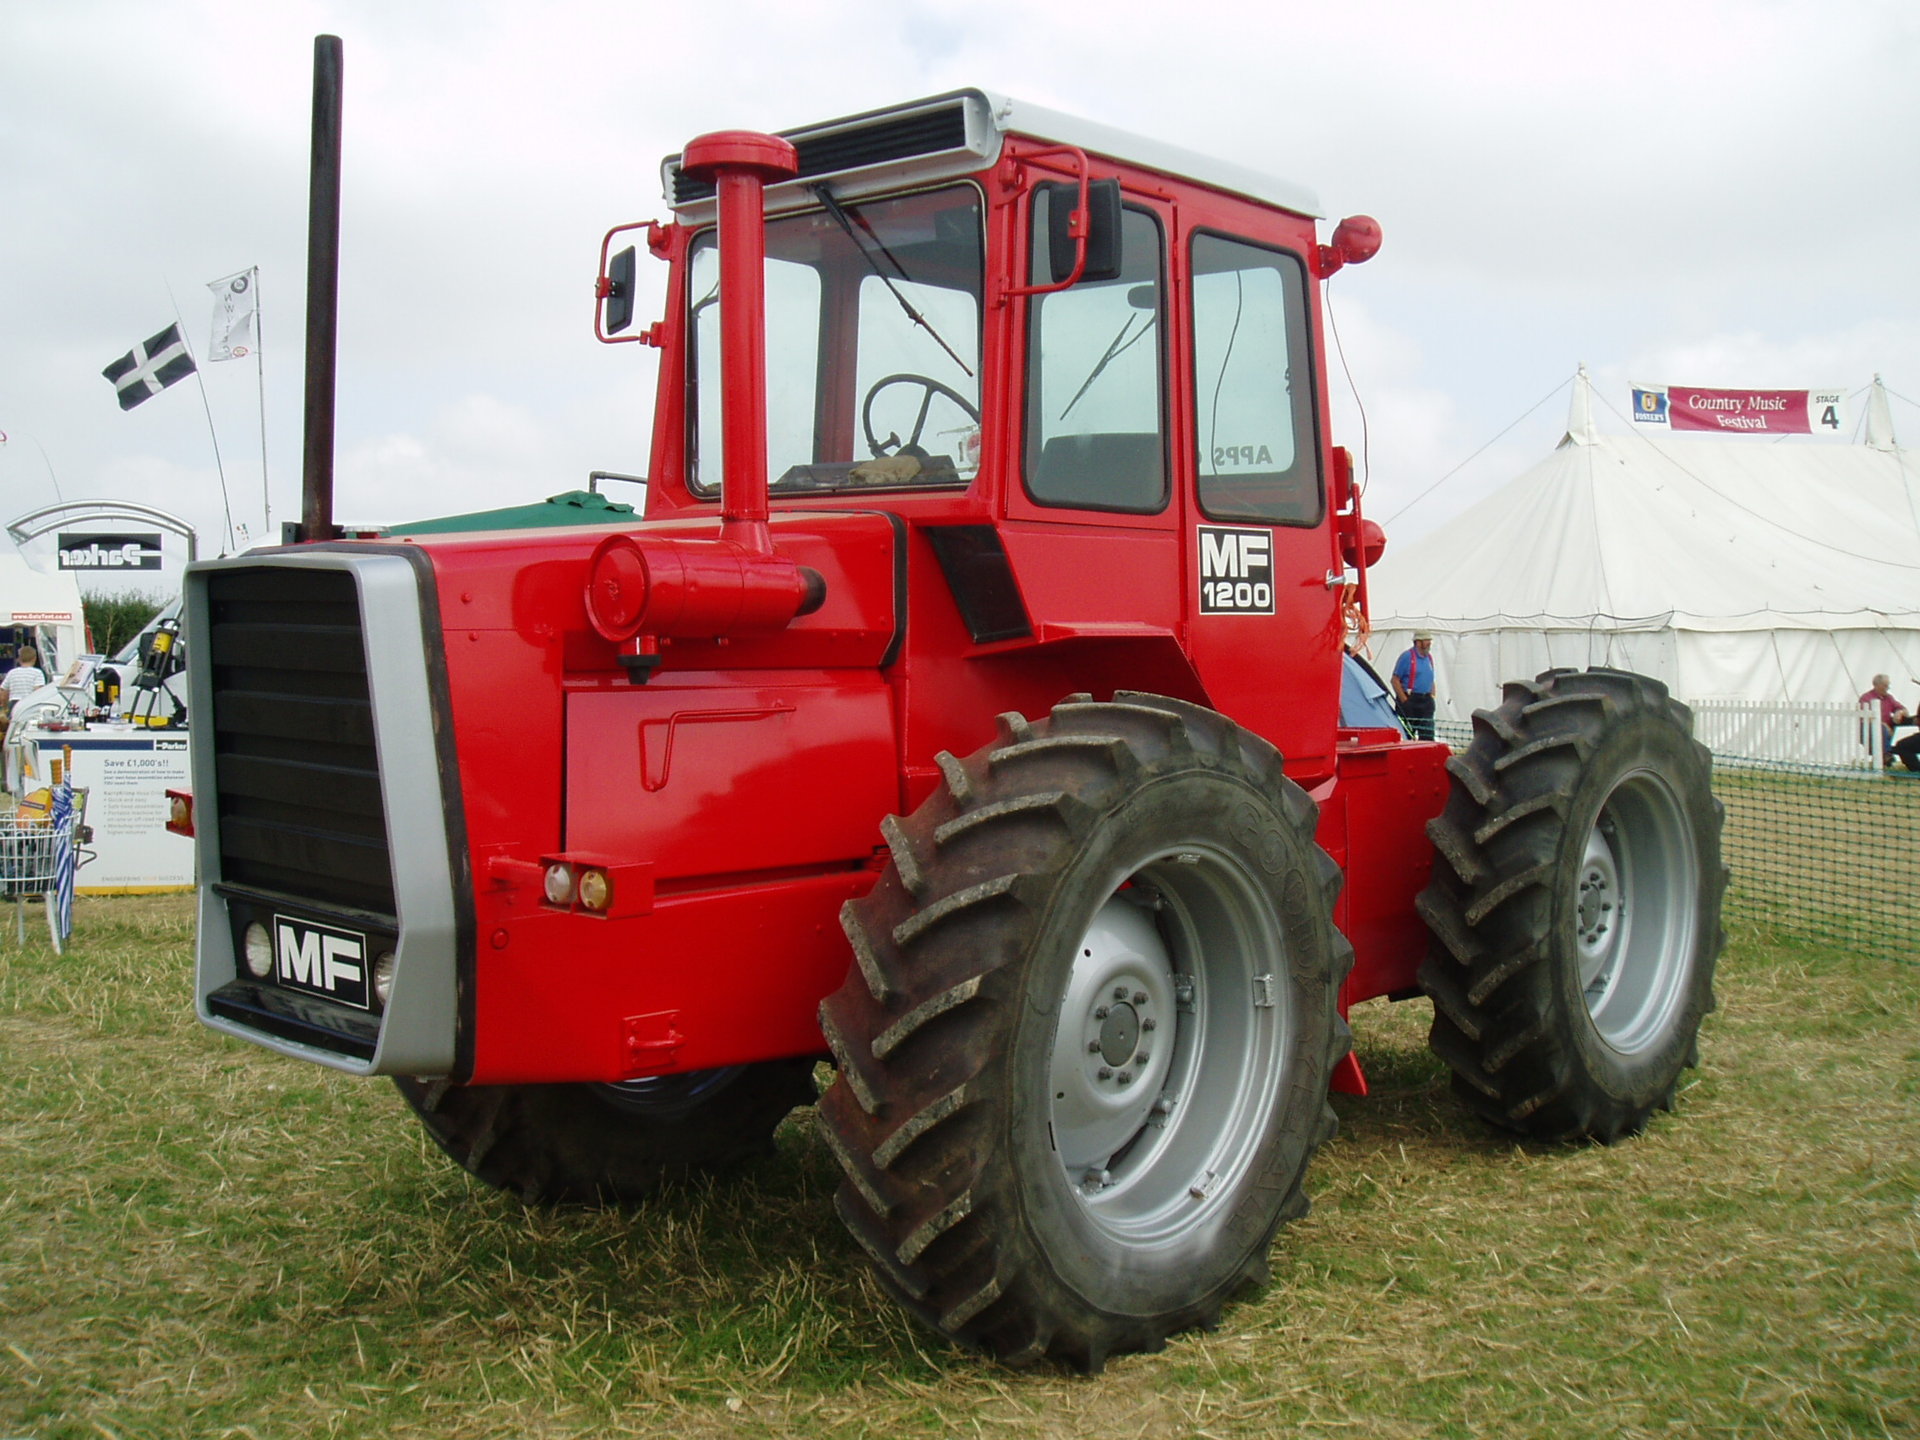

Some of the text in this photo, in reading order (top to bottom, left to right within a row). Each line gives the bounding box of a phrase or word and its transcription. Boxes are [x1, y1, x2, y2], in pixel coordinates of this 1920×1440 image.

[1688, 394, 1787, 413] Country Music
[1815, 395, 1840, 404] STAGE
[1716, 414, 1767, 430] Festival
[1820, 405, 1839, 430] 4
[1201, 533, 1269, 578] MF
[1203, 581, 1271, 608] 1200
[161, 742, 188, 750] Parker
[104, 759, 125, 767] Save
[279, 924, 361, 991] MF
